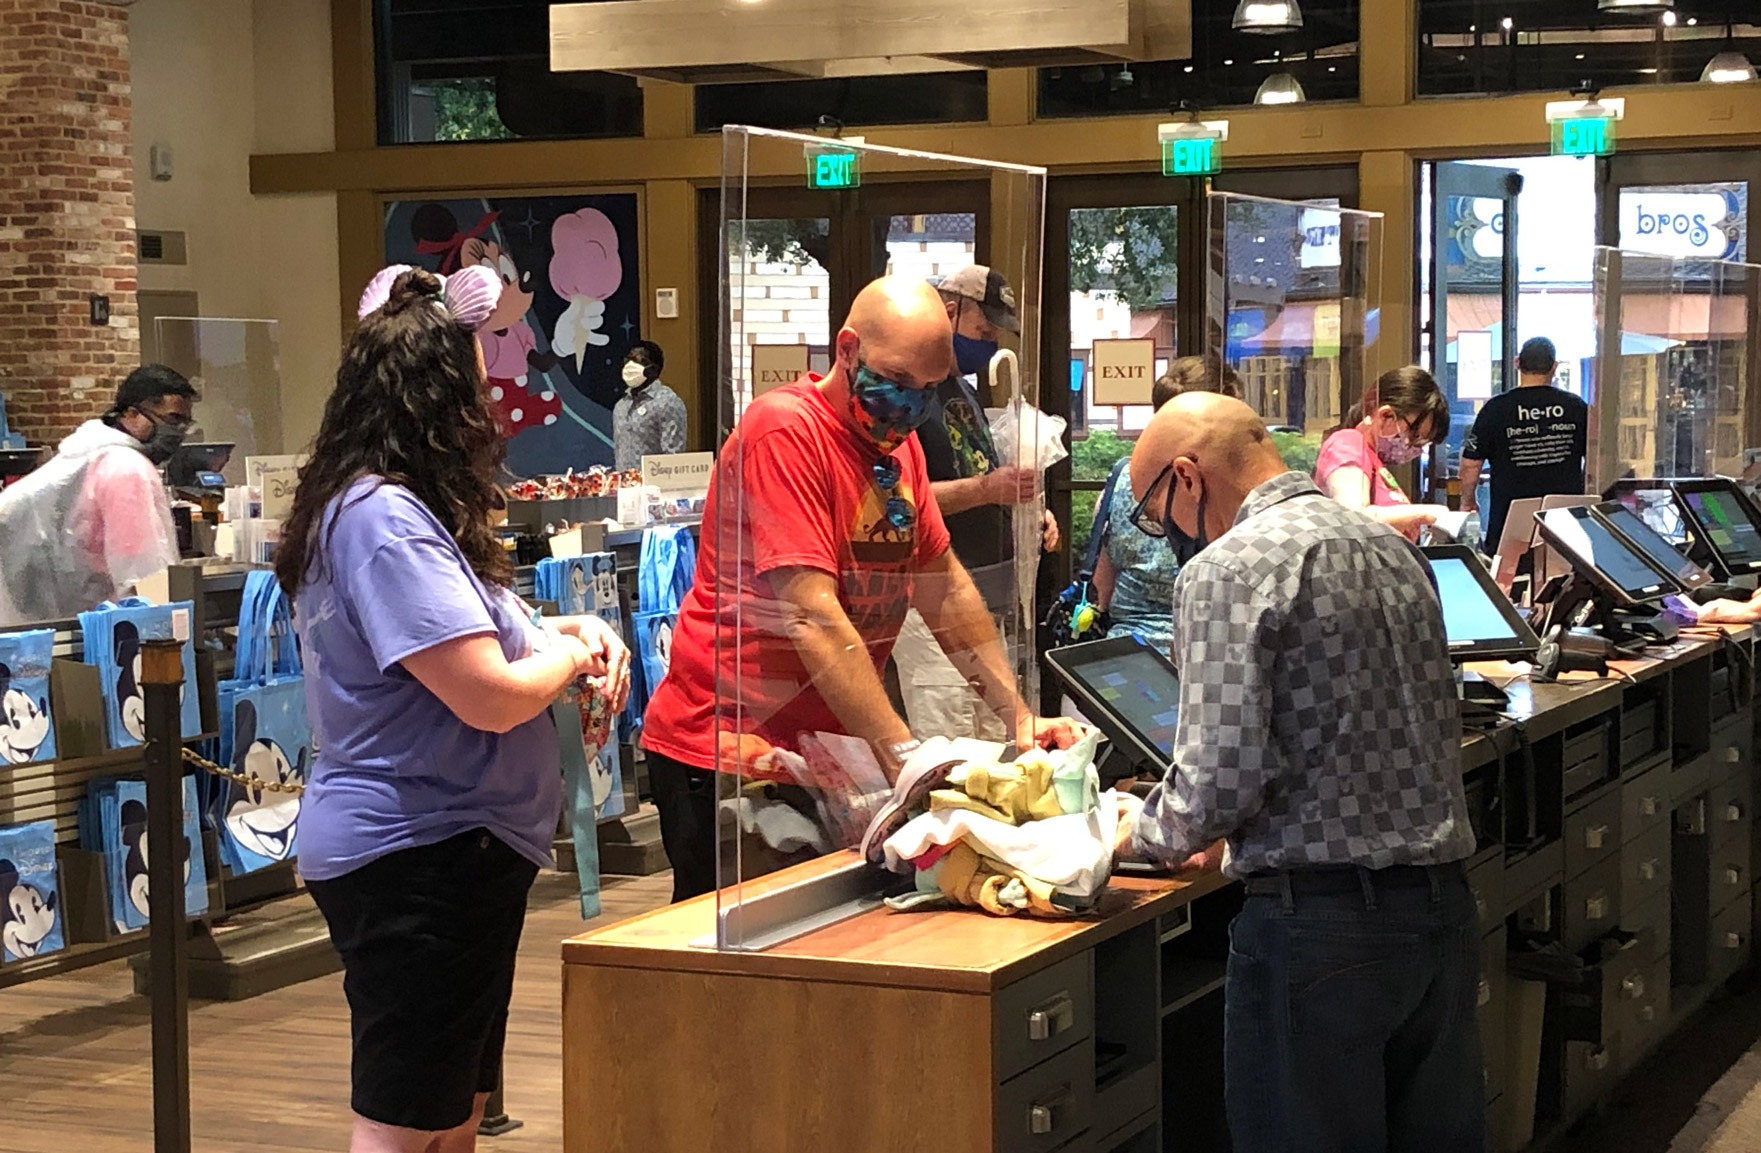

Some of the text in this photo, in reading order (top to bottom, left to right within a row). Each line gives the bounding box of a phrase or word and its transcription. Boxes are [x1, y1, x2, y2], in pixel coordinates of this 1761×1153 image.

[1563, 117, 1608, 152] EXIT
[816, 154, 855, 186] EXIT
[1173, 138, 1214, 172] EXIT
[1636, 204, 1709, 247] bros
[761, 369, 802, 382] EXIT
[1102, 365, 1146, 378] EXIT
[674, 465, 690, 475] GIFT
[691, 464, 709, 473] CARD
